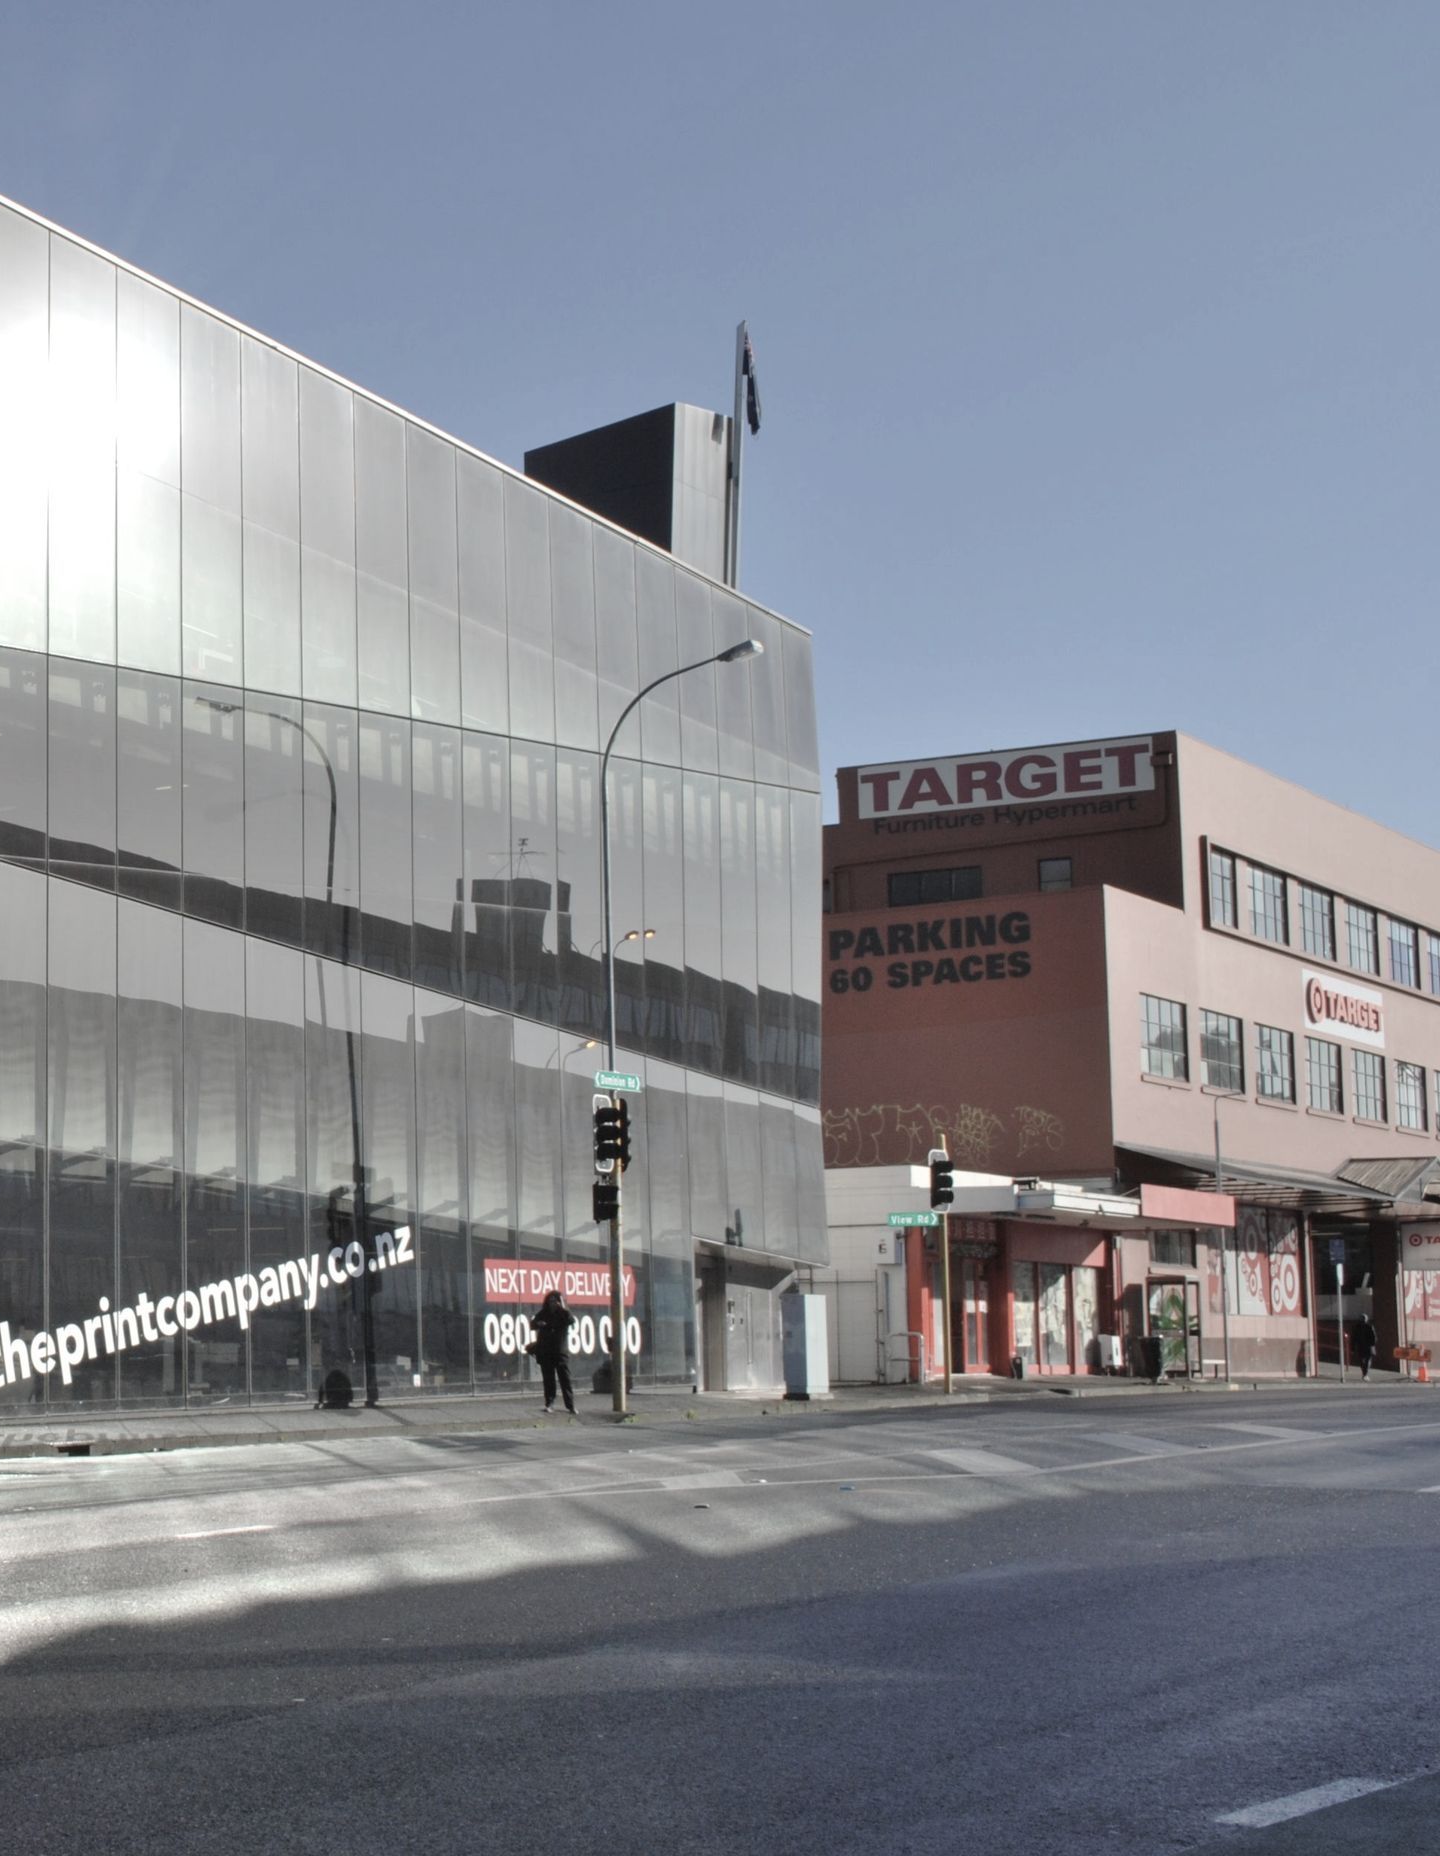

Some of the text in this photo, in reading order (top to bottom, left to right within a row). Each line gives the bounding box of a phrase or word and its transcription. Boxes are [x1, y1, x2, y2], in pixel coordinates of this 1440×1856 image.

[860, 743, 1150, 812] TARGET
[874, 797, 1136, 835] Furniture Hypermart
[828, 911, 1031, 960] PARKING
[829, 951, 1032, 993] 60 SPACES
[1323, 990, 1382, 1032] TARGET
[891, 1214, 929, 1225] View Rd
[484, 1268, 631, 1297] NEXT DAY DELIVEY
[484, 1313, 537, 1354] 080
